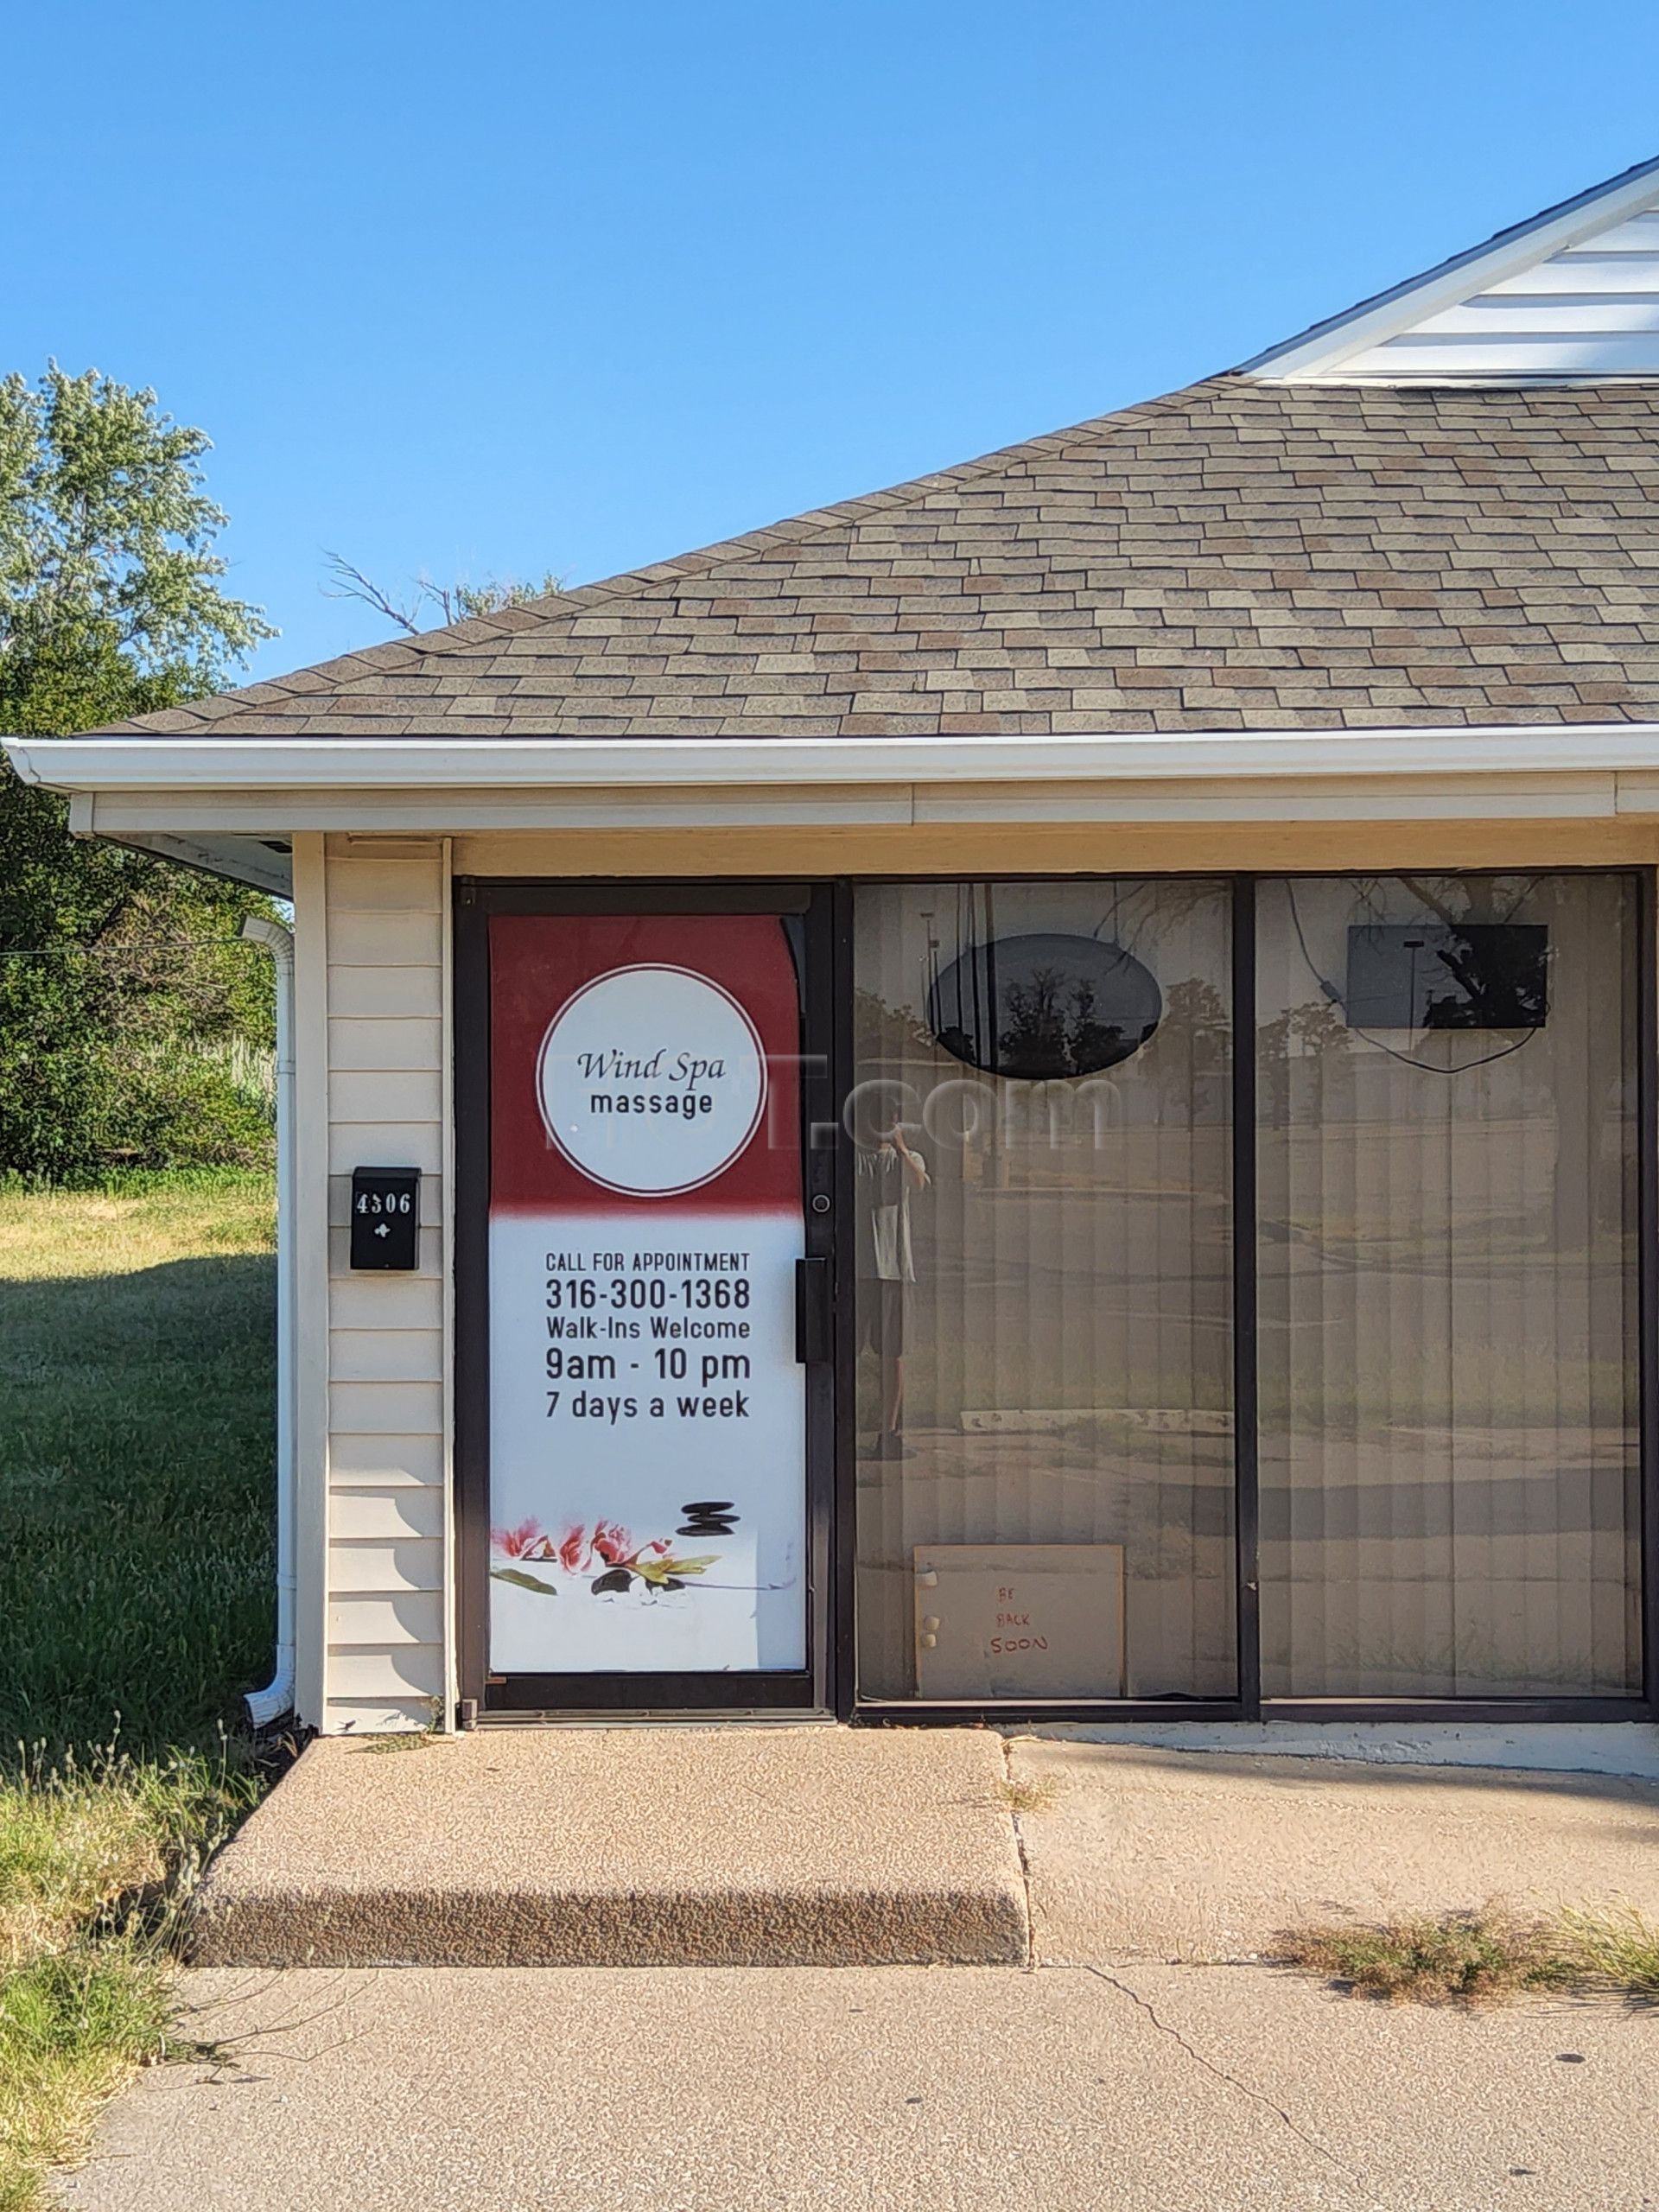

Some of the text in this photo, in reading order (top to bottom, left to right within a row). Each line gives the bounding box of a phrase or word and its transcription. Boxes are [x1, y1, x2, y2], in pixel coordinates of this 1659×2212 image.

[577, 1049, 725, 1090] Wind Spa
[591, 1095, 712, 1120] massage
[547, 1253, 749, 1271] CALL FOR APPOINTMENT
[547, 1279, 749, 1309] 316-300-1368
[547, 1317, 749, 1338] Walk-Ins Welcome
[547, 1348, 615, 1379] 9am
[655, 1348, 686, 1379] 10
[702, 1355, 750, 1388] pm
[547, 1389, 748, 1425] 7 days a week
[996, 1613, 1030, 1628] BACK
[990, 1636, 1048, 1654] SOON
